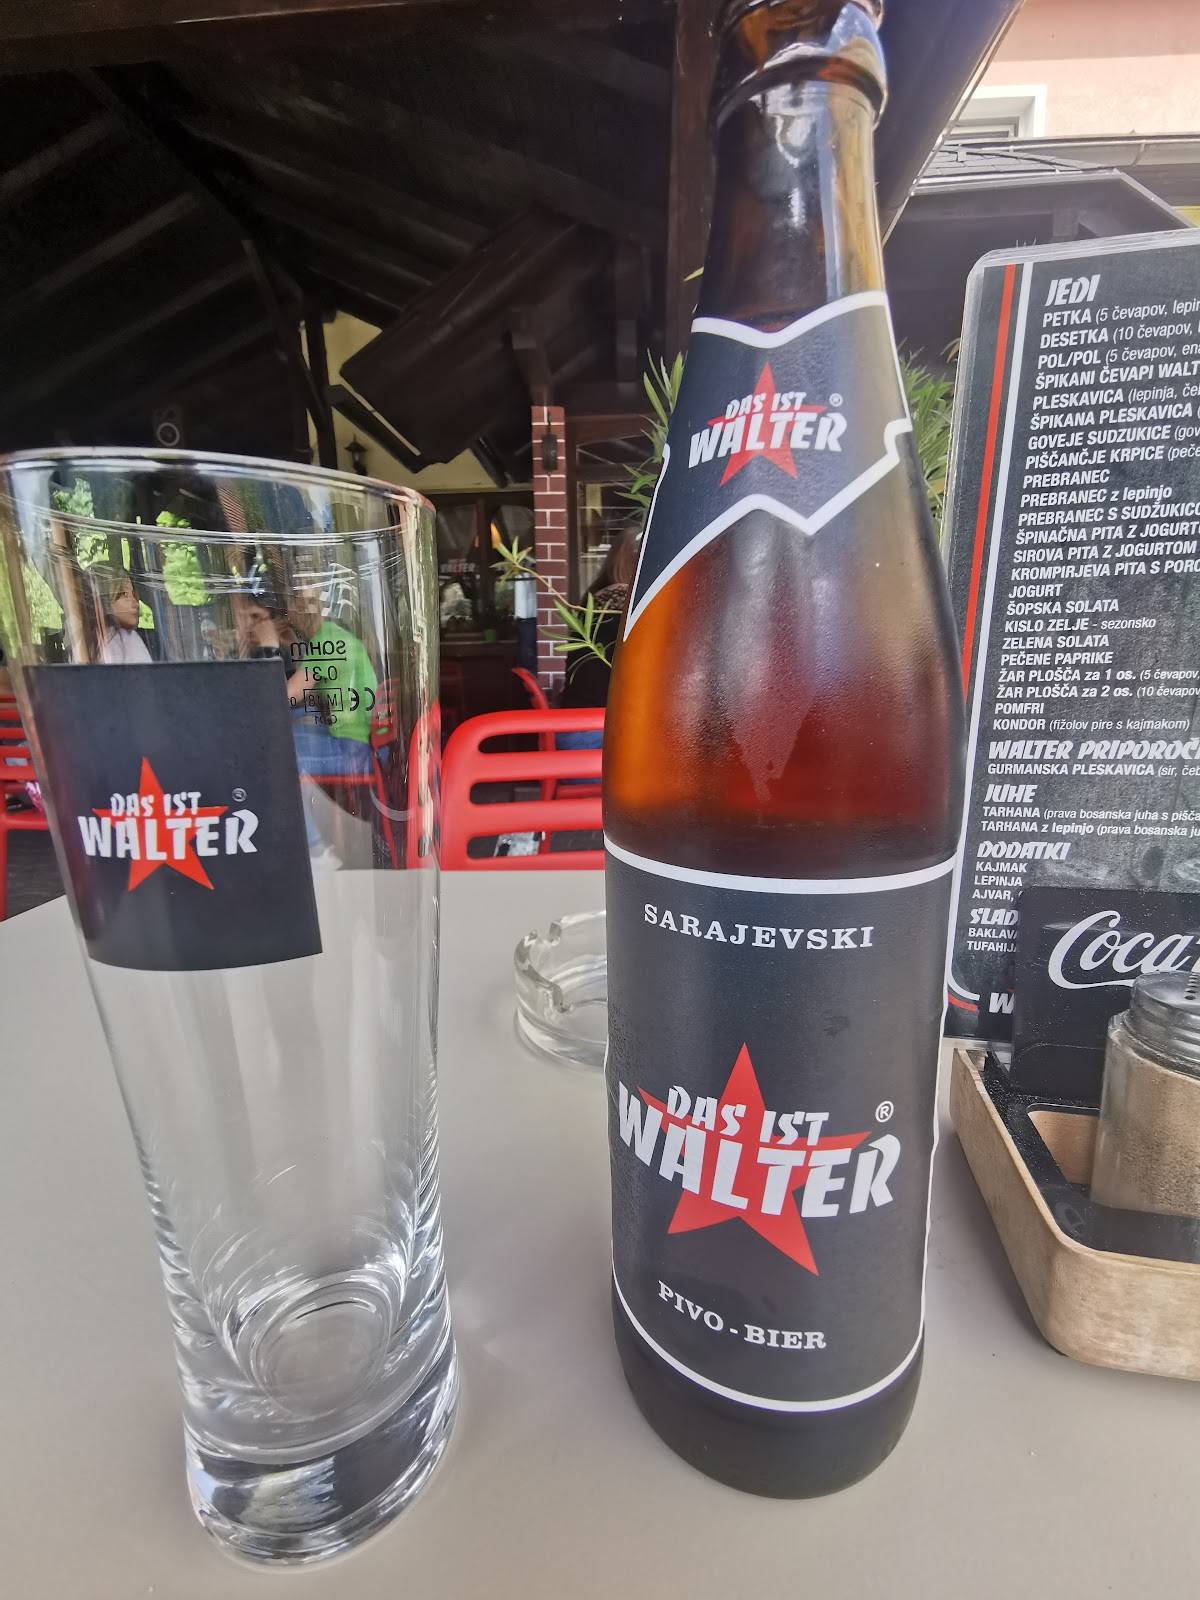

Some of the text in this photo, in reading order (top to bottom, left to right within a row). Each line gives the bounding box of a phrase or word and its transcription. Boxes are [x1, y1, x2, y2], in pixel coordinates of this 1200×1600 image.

[1045, 274, 1100, 306] JEDI
[1043, 308, 1091, 327] PETKA
[1096, 308, 1108, 325] (5
[1112, 304, 1168, 320] čevapov,
[1040, 328, 1108, 349] DESETKA
[1113, 327, 1133, 344] (10
[1137, 323, 1192, 339] čevapov,
[1038, 350, 1101, 369] POL/POL
[1106, 348, 1118, 366] (5
[1122, 345, 1177, 361] čevapov,
[1035, 370, 1095, 390] ŠPIKANI
[1100, 365, 1154, 384] ČEVAPI
[725, 391, 806, 419] DAS IST
[1033, 388, 1123, 410] PLESKAVICA
[1128, 386, 1177, 404] (lepinja,
[1030, 411, 1095, 430] ŠPIKANA
[1100, 402, 1192, 424] PLESKAVICA
[689, 412, 847, 468] WALTER
[1028, 432, 1084, 450] GOVEJE
[1087, 425, 1171, 445] SUDZUKICE
[1025, 448, 1107, 469] PIŠČANČJE
[1110, 445, 1165, 463] KRPICE
[1023, 469, 1110, 489] PREBRANEC
[1020, 485, 1172, 508] PREBRANEC z lepinjo
[1018, 508, 1104, 527] PREBRANEC
[1107, 507, 1118, 521] S
[1015, 521, 1200, 545] ŠPINAČNA PITA Z JOGURT
[1013, 540, 1197, 563] SIROVA PITA Z JOGURTOM
[1011, 564, 1110, 581] KROMPIRJEVA
[1114, 561, 1146, 576] PITA
[1150, 560, 1161, 574] S
[1008, 584, 1063, 598] JOGURT
[1006, 599, 1119, 616] ŠOPSKA SOLATA
[1004, 619, 1044, 633] KISLO
[1047, 618, 1090, 632] ZELJE
[1101, 617, 1157, 630] sezonsko
[1002, 634, 1110, 650] ZELENA SOLATA
[1000, 651, 1114, 666] PEČENE PAPRIKE
[998, 667, 1026, 683] ŽAR
[1028, 666, 1081, 682] PLOŠČA
[1084, 671, 1100, 681] za
[1105, 668, 1112, 680] 1
[1116, 671, 1136, 681] os.
[1140, 669, 1151, 682] (5
[996, 684, 1023, 699] ŽAR
[1026, 683, 1078, 698] PLOŠČA
[1081, 687, 1098, 698] za
[1100, 685, 1110, 697] 2
[1113, 687, 1133, 697] os.
[1136, 685, 1154, 699] (10
[994, 702, 1045, 714] POMFRI
[993, 719, 1046, 730] KONDOR
[1090, 719, 1113, 731] pire
[1116, 721, 1123, 730] s
[1126, 719, 1190, 732] kajmakom)
[988, 740, 1074, 760] WALTER
[988, 763, 1069, 775] GURMANSKA
[1072, 763, 1154, 775] PLESKAVICA
[984, 783, 1038, 803] JUHE
[110, 792, 201, 817] DAS IST
[982, 806, 1041, 818] TARHANA
[1043, 809, 1077, 820] (prava
[1079, 808, 1132, 820] bosanska
[1133, 809, 1159, 822] juha
[77, 809, 259, 860] WALTER
[980, 820, 1038, 832] TARHANA
[1041, 824, 1049, 833] z
[1051, 822, 1094, 836] lepinjo
[1096, 823, 1132, 836] (prava
[1133, 824, 1188, 837] bosanska
[977, 840, 1070, 860] DODATKI
[976, 862, 1028, 873] KAJMAK
[974, 875, 1022, 887] LEPINJA
[972, 889, 1014, 902] AJVAR,
[644, 903, 874, 950] SARAJEVSKI
[667, 1085, 829, 1146] DAS IST
[619, 1080, 901, 1217] WALTER
